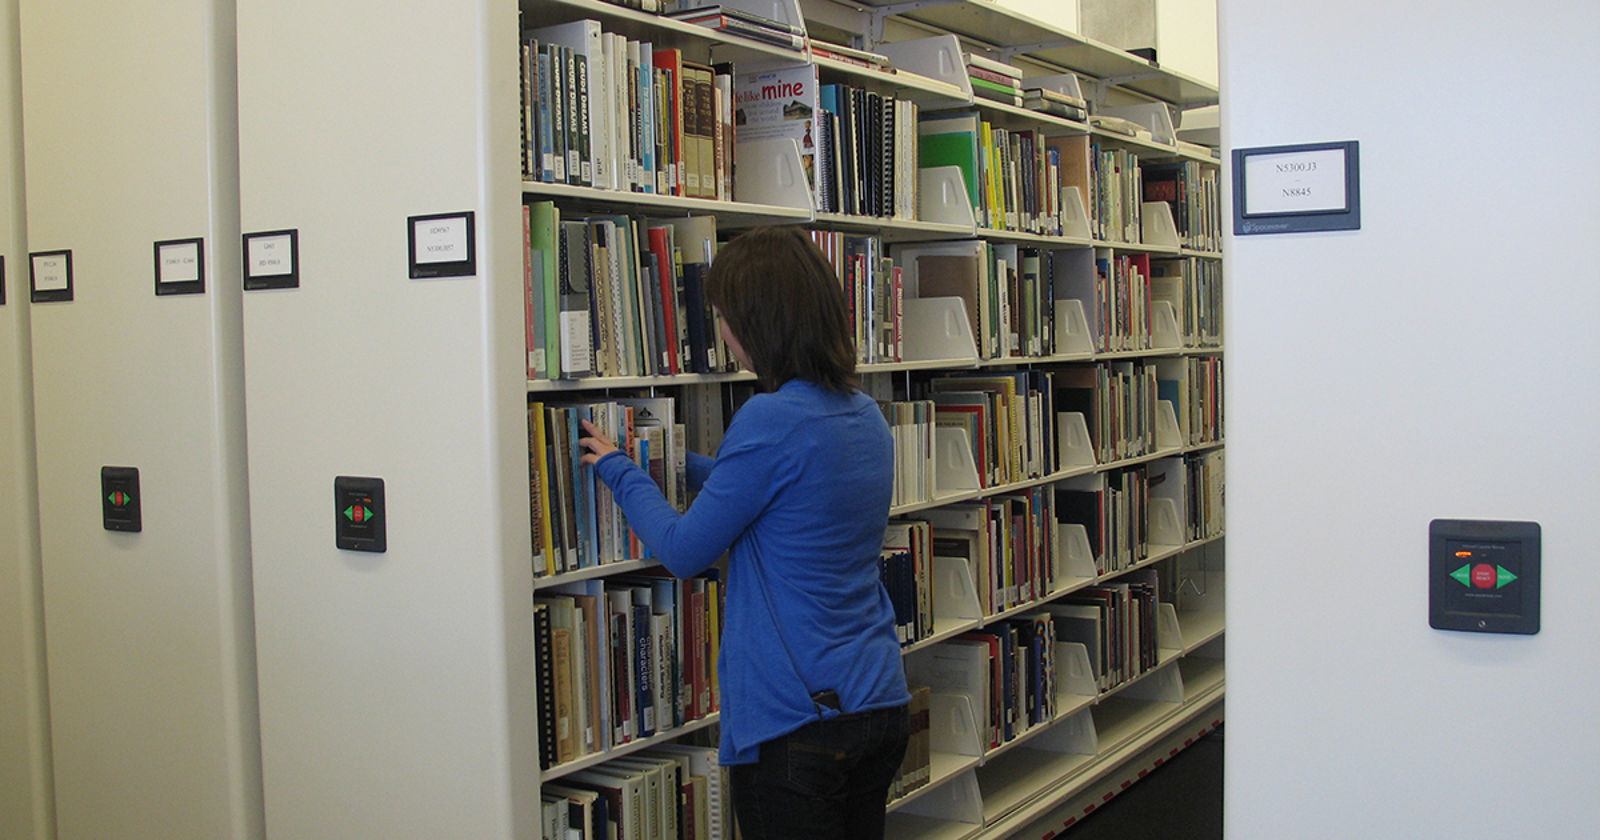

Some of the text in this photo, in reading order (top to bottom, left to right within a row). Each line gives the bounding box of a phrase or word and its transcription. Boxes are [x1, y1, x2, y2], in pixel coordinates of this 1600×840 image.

[568, 57, 576, 89] CRUDE
[579, 61, 587, 93] CRUDE
[744, 91, 760, 102] like
[762, 80, 804, 100] mine
[1276, 162, 1317, 173] N5300.J3
[1282, 187, 1312, 197] N8845
[639, 637, 649, 691] characters
